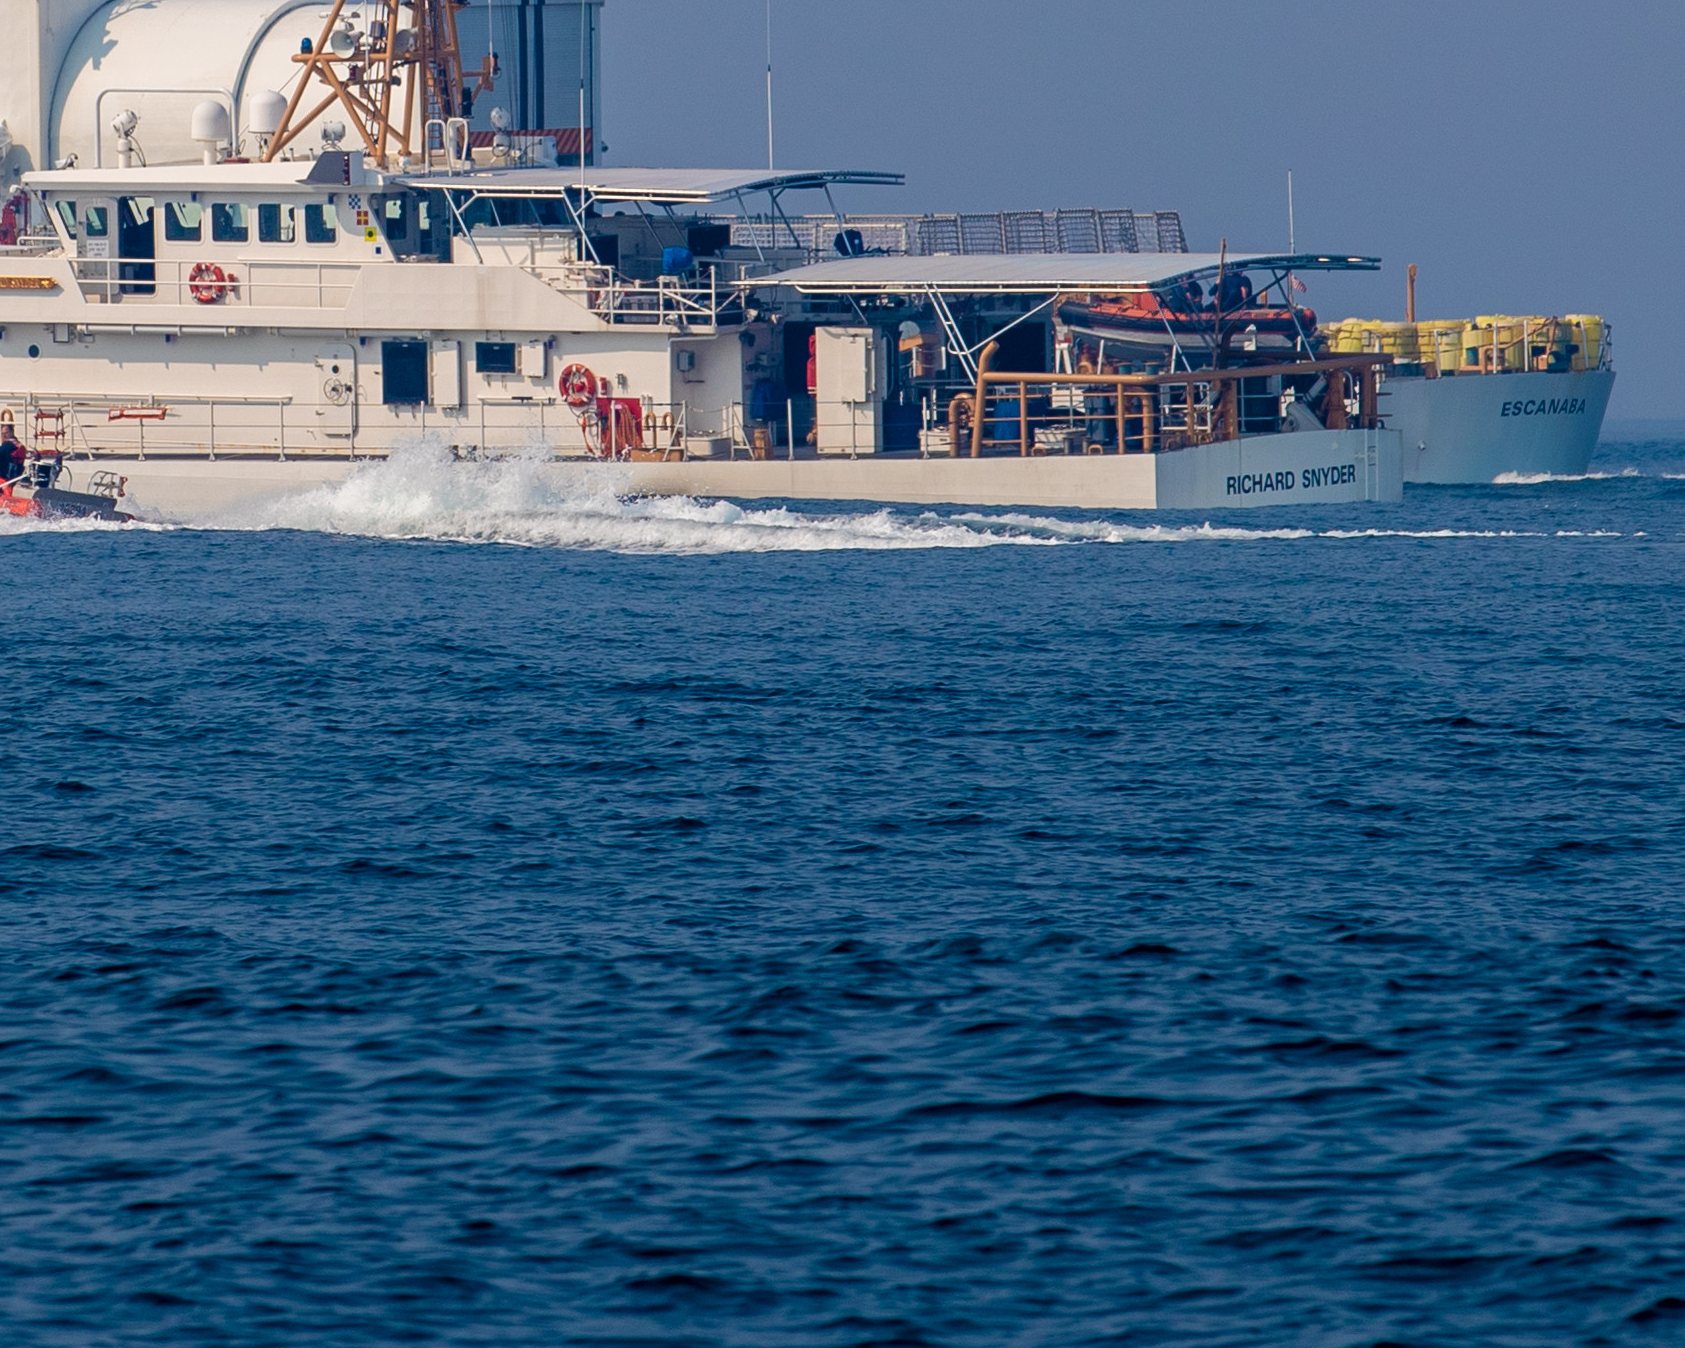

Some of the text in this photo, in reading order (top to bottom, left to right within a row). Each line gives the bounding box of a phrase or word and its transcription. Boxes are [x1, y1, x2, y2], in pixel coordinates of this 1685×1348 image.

[1500, 398, 1586, 417] ESCANABA
[1226, 464, 1356, 495] RICHARD SNYDER
